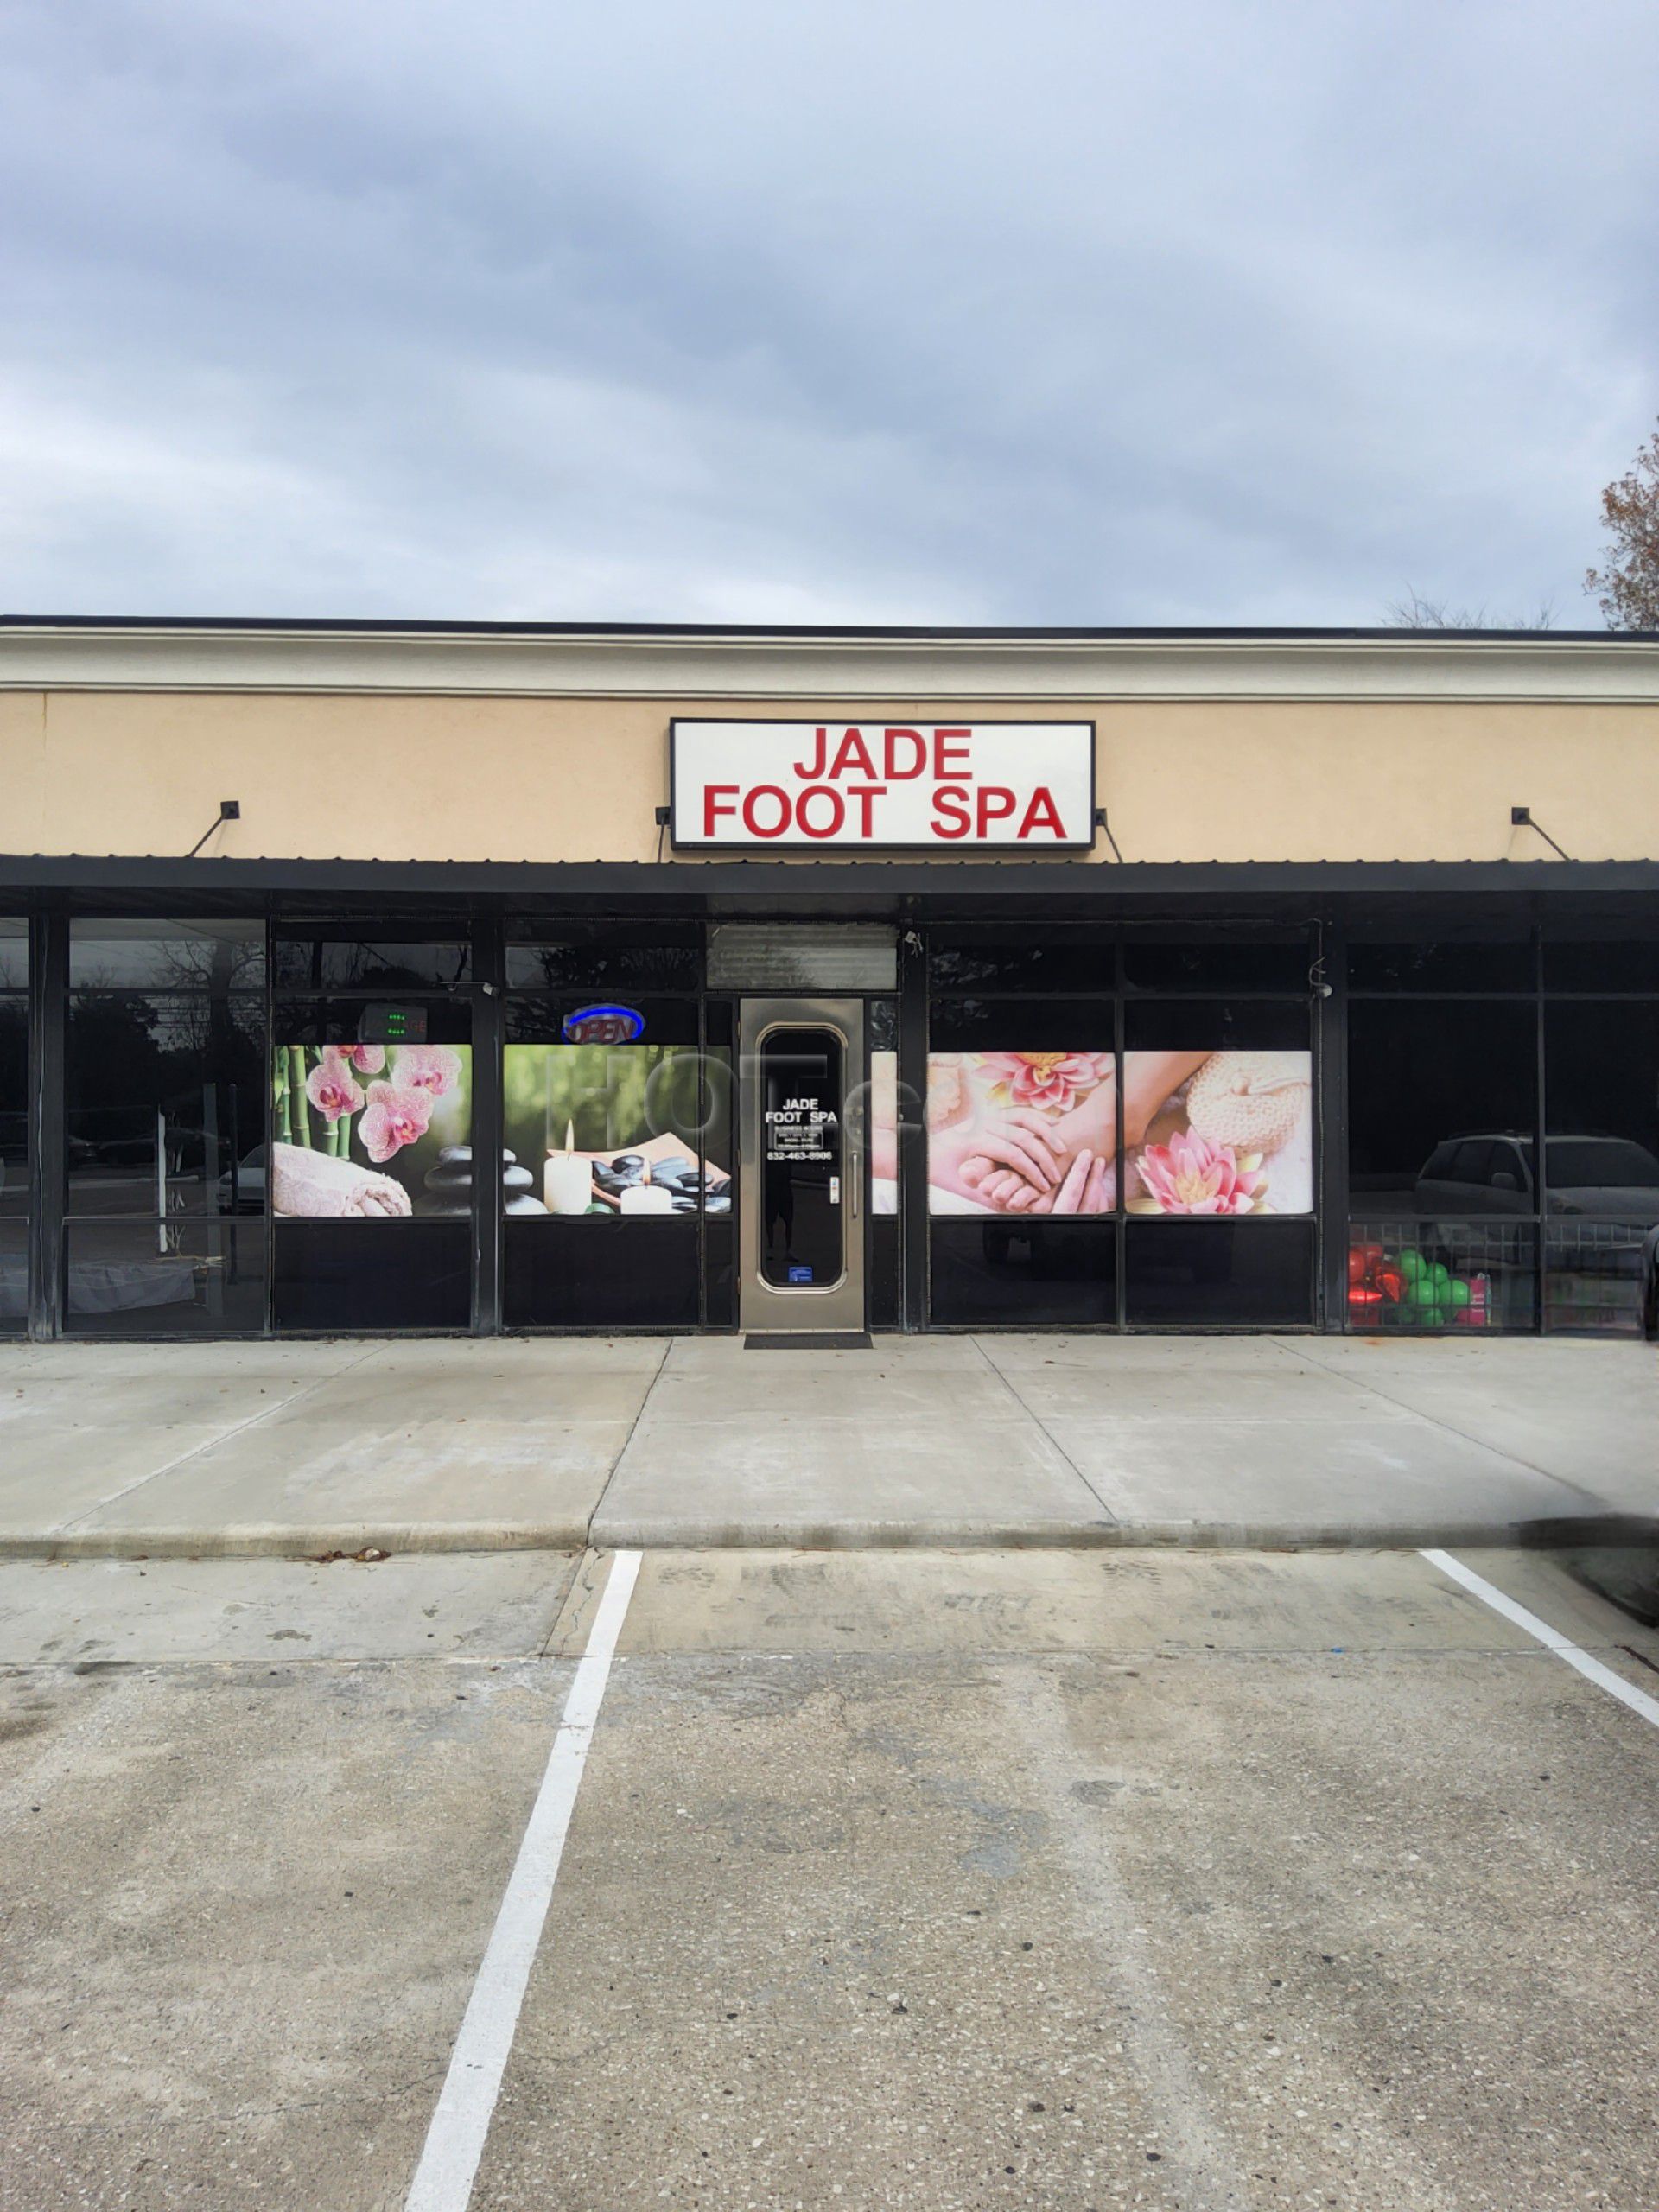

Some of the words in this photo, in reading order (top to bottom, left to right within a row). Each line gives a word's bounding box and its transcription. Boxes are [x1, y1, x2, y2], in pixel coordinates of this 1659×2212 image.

[793, 728, 973, 781] JADE
[702, 785, 887, 839] FOOT
[930, 786, 1068, 840] SPA
[566, 1019, 634, 1043] OPEN
[783, 1098, 819, 1110] JADE
[766, 1111, 803, 1123] FOOT
[810, 1111, 838, 1123] SPA
